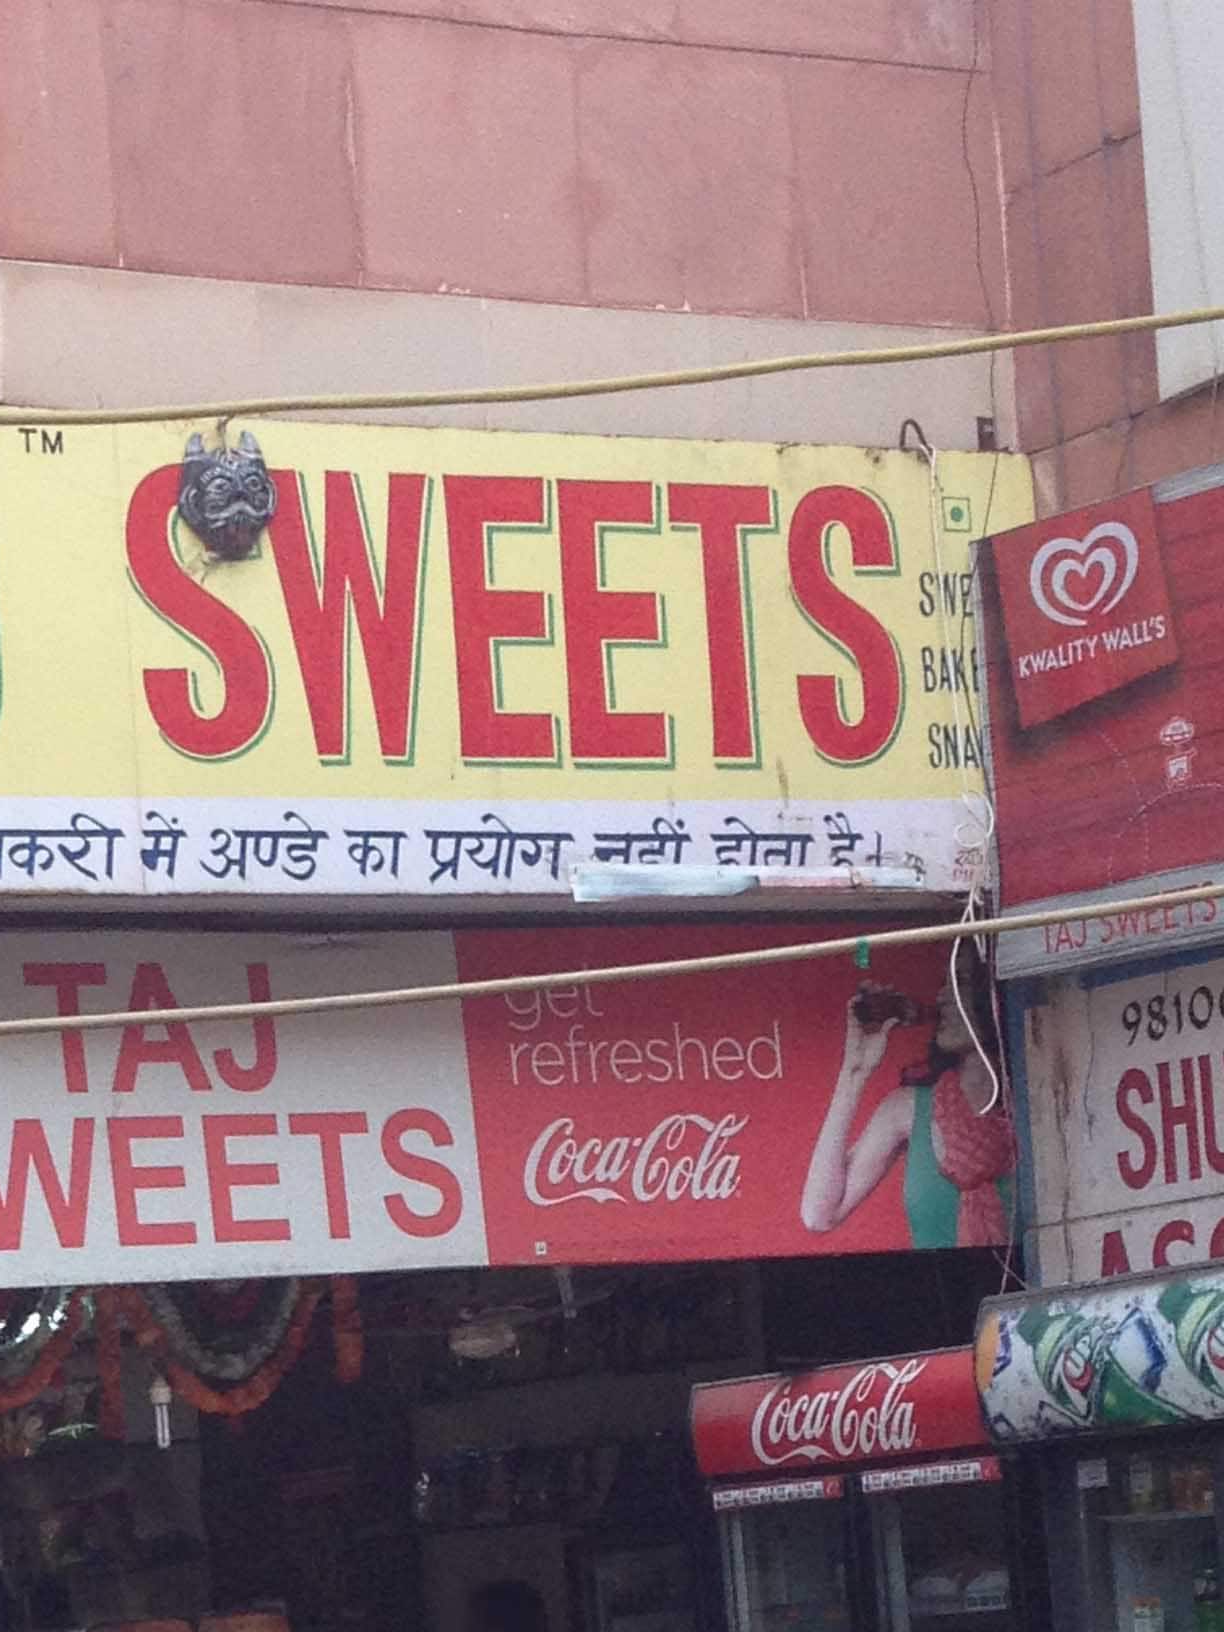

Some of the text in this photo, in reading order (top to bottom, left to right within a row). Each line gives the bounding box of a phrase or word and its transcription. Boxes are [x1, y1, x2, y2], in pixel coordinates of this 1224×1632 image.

[18, 427, 64, 454] TM
[125, 464, 904, 771] SWEETS
[1018, 614, 1166, 678] KWALITY WALL'S
[142, 811, 185, 880] में
[201, 811, 329, 880] अण्डे
[344, 828, 407, 880] का
[425, 812, 575, 884] प्रयोग
[22, 961, 280, 1094] TAJ
[508, 1020, 783, 1086] refreshed
[1122, 985, 1224, 1046] 9810
[524, 1113, 750, 1206] Coca-Cola
[751, 1358, 928, 1465] Coca-Cola
